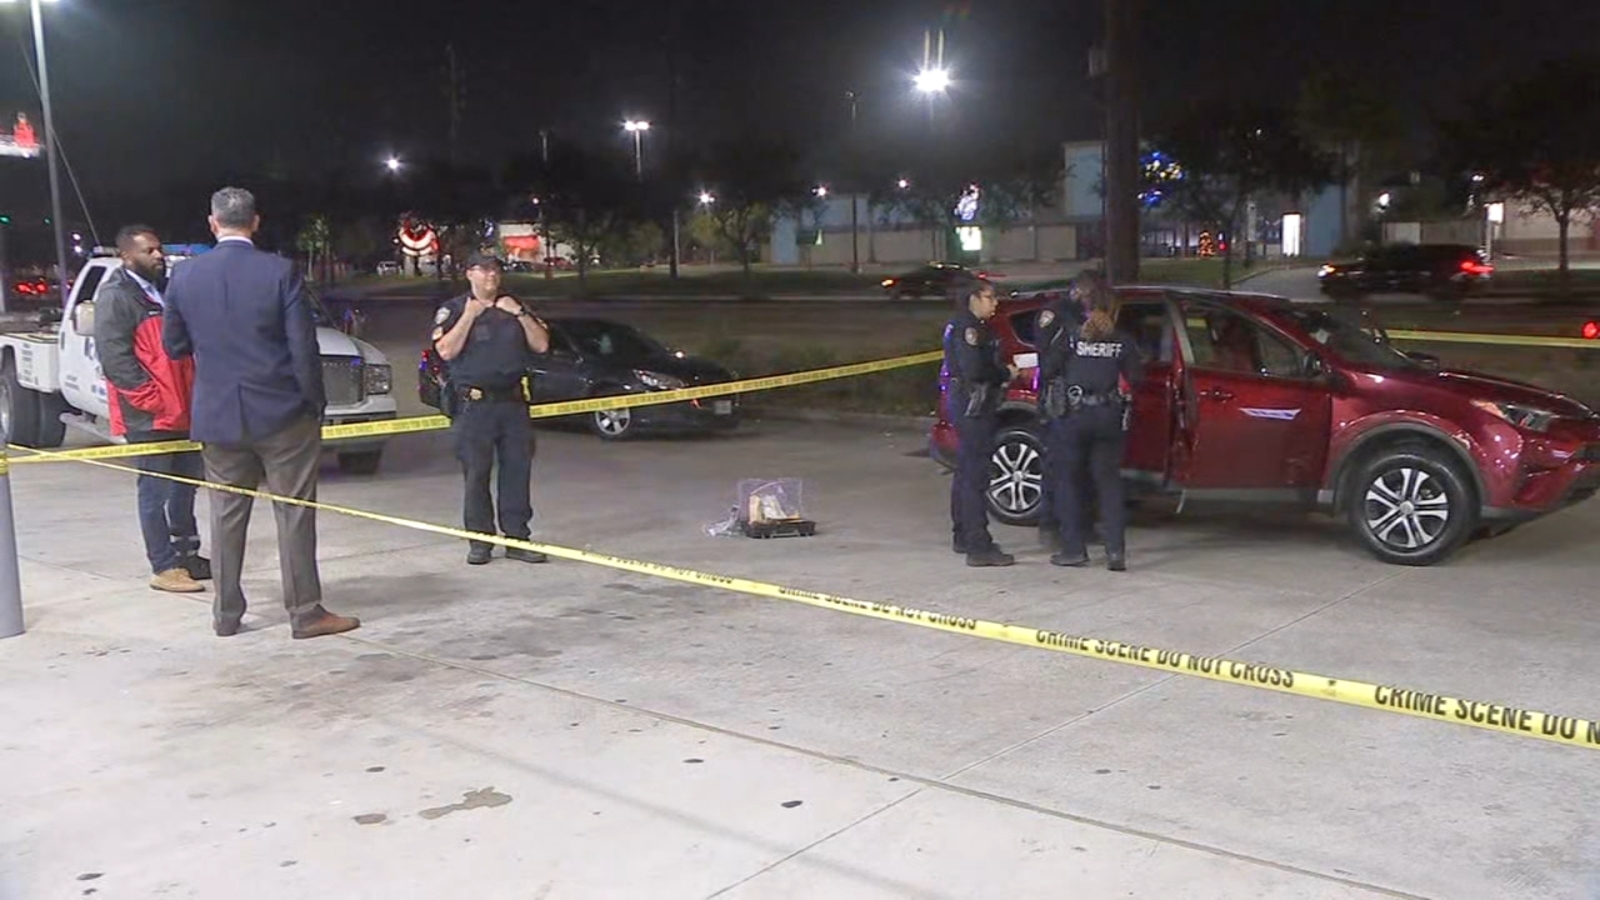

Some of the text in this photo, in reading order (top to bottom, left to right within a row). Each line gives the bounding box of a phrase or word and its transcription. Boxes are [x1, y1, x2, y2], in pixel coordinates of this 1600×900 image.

[1076, 341, 1122, 358] SHERIFF
[1036, 629, 1294, 688] CRIME SCENE DO NOT CROSS
[1374, 684, 1447, 716] CRIME
[1454, 698, 1533, 732] SCENE
[1542, 714, 1577, 740] DO
